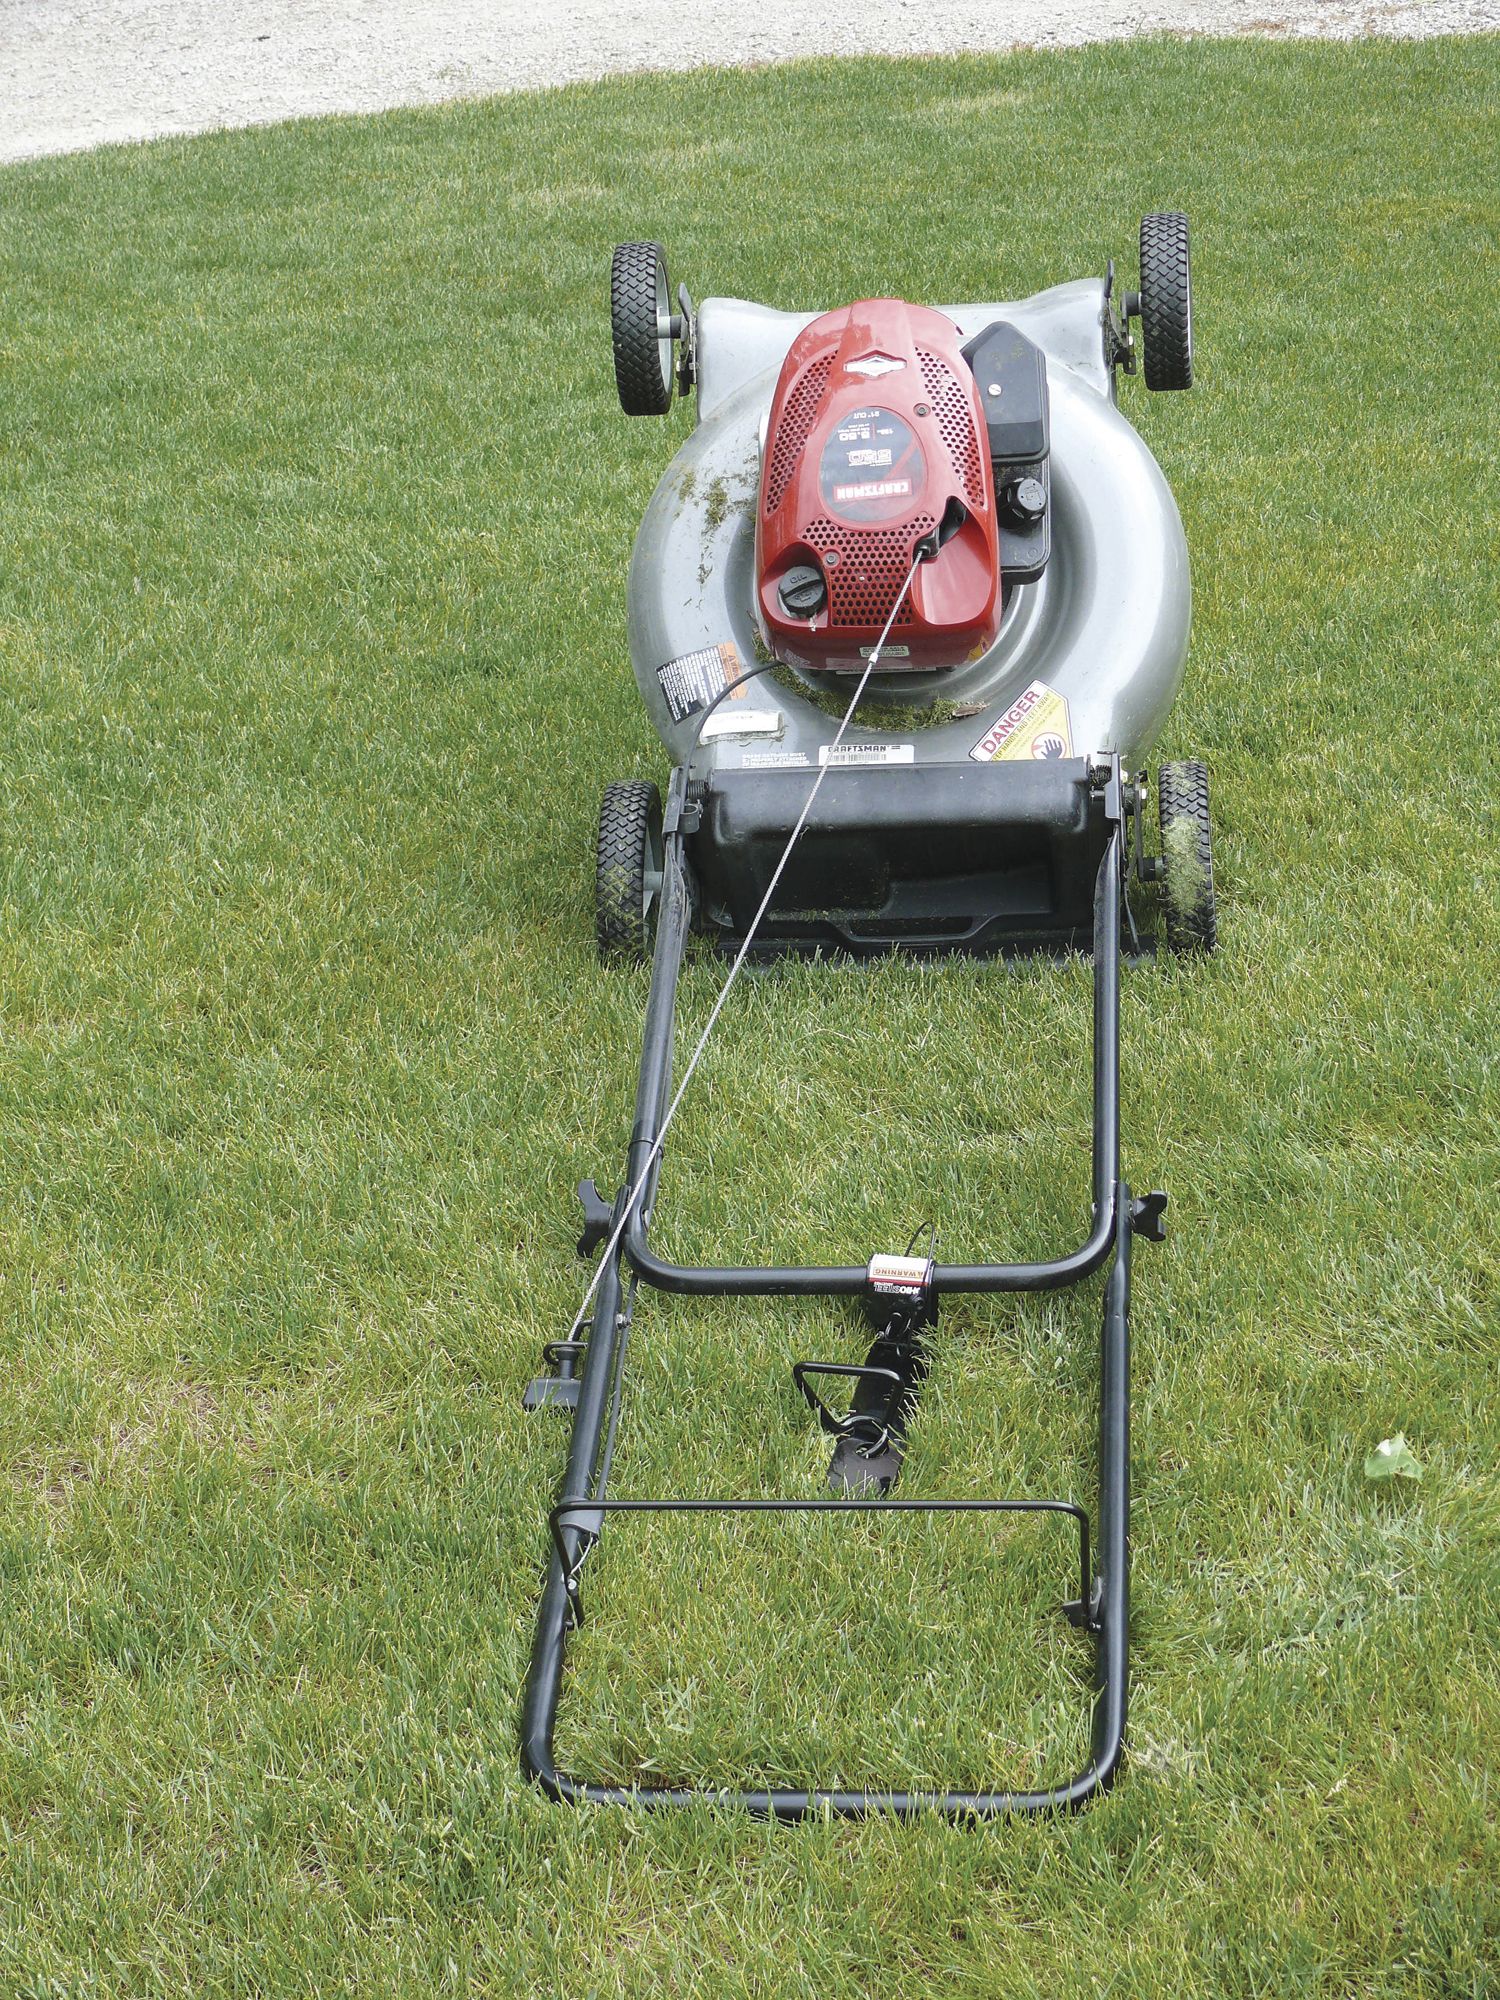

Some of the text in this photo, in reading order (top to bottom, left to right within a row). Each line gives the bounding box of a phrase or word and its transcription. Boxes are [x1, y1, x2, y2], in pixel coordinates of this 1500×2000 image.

[837, 482, 908, 499] CRAFTSMAN
[790, 573, 808, 584] OIL
[982, 691, 1040, 753] DANGER
[1003, 733, 1018, 751] HANDS
[1016, 722, 1028, 733] AND
[1026, 709, 1038, 722] FEET
[875, 1268, 915, 1276] WARNING
